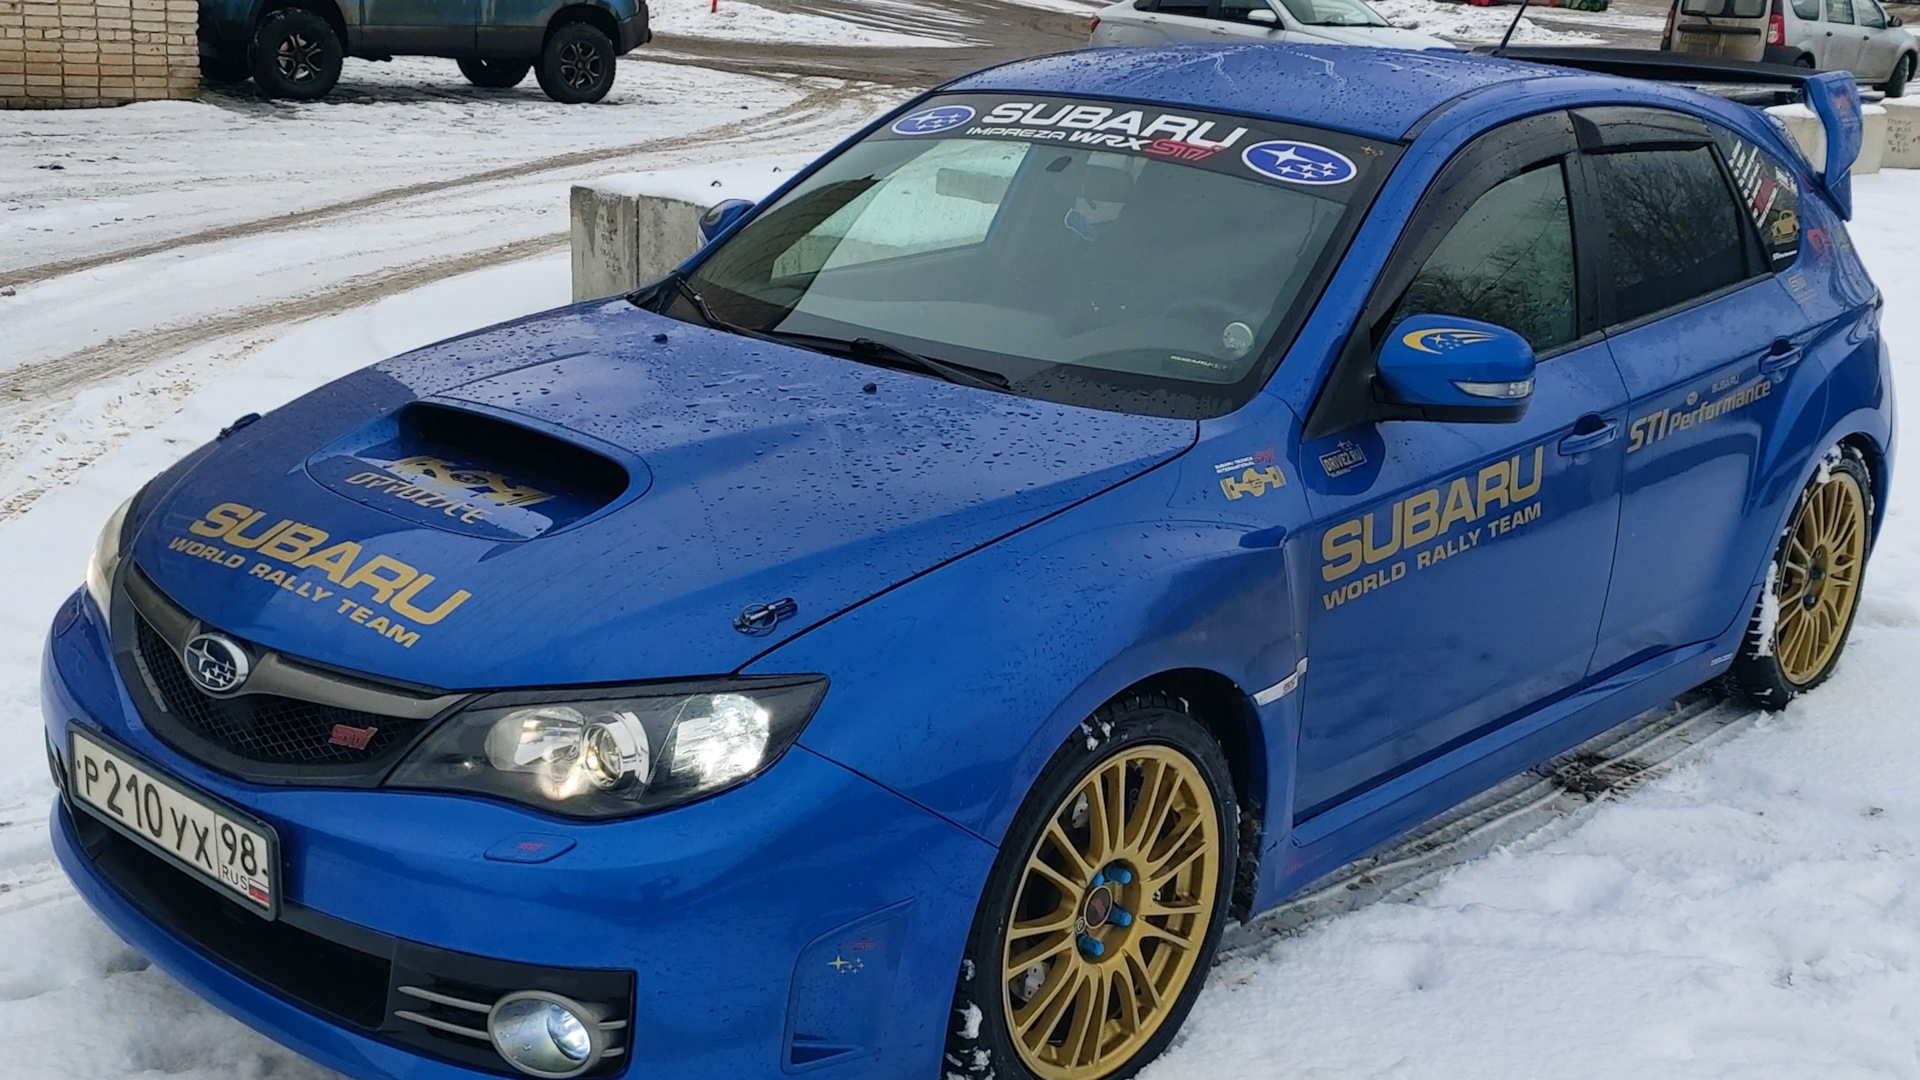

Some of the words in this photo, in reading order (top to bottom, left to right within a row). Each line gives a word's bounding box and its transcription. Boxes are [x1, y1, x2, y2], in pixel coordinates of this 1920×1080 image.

[966, 127, 1067, 140] IMPREZA
[1068, 131, 1154, 150] WRX
[982, 103, 1249, 148] SUBARU
[1626, 408, 1671, 454] STI
[1668, 380, 1771, 436] Performance
[1322, 445, 1544, 582] SUBARU
[167, 537, 246, 569] WORLD
[248, 563, 334, 603] RALLY
[337, 598, 422, 649] TEAM
[189, 502, 474, 625] SUBARU
[1323, 561, 1406, 611] WORLD
[1417, 527, 1482, 571] RALLY
[1488, 501, 1542, 539] TEAM
[220, 822, 257, 877] 98
[222, 864, 249, 891] RUS
